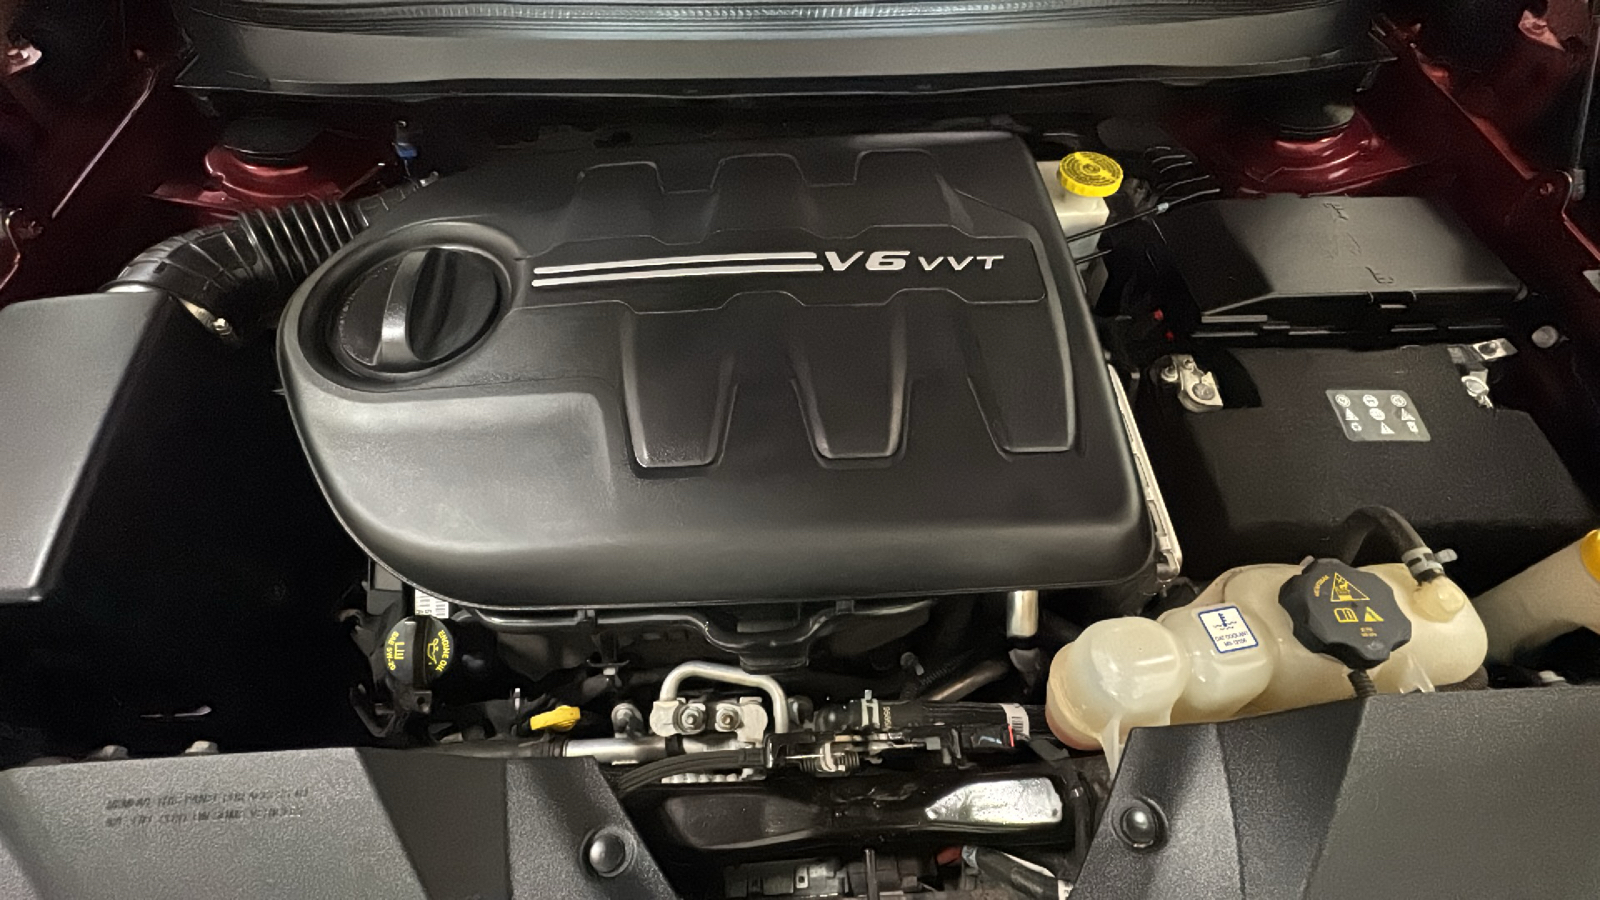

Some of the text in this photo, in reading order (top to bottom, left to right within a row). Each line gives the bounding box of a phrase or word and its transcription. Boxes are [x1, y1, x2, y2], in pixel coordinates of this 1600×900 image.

[824, 251, 1004, 271] V6 VVT
[435, 630, 450, 672] ENGINE OIL
